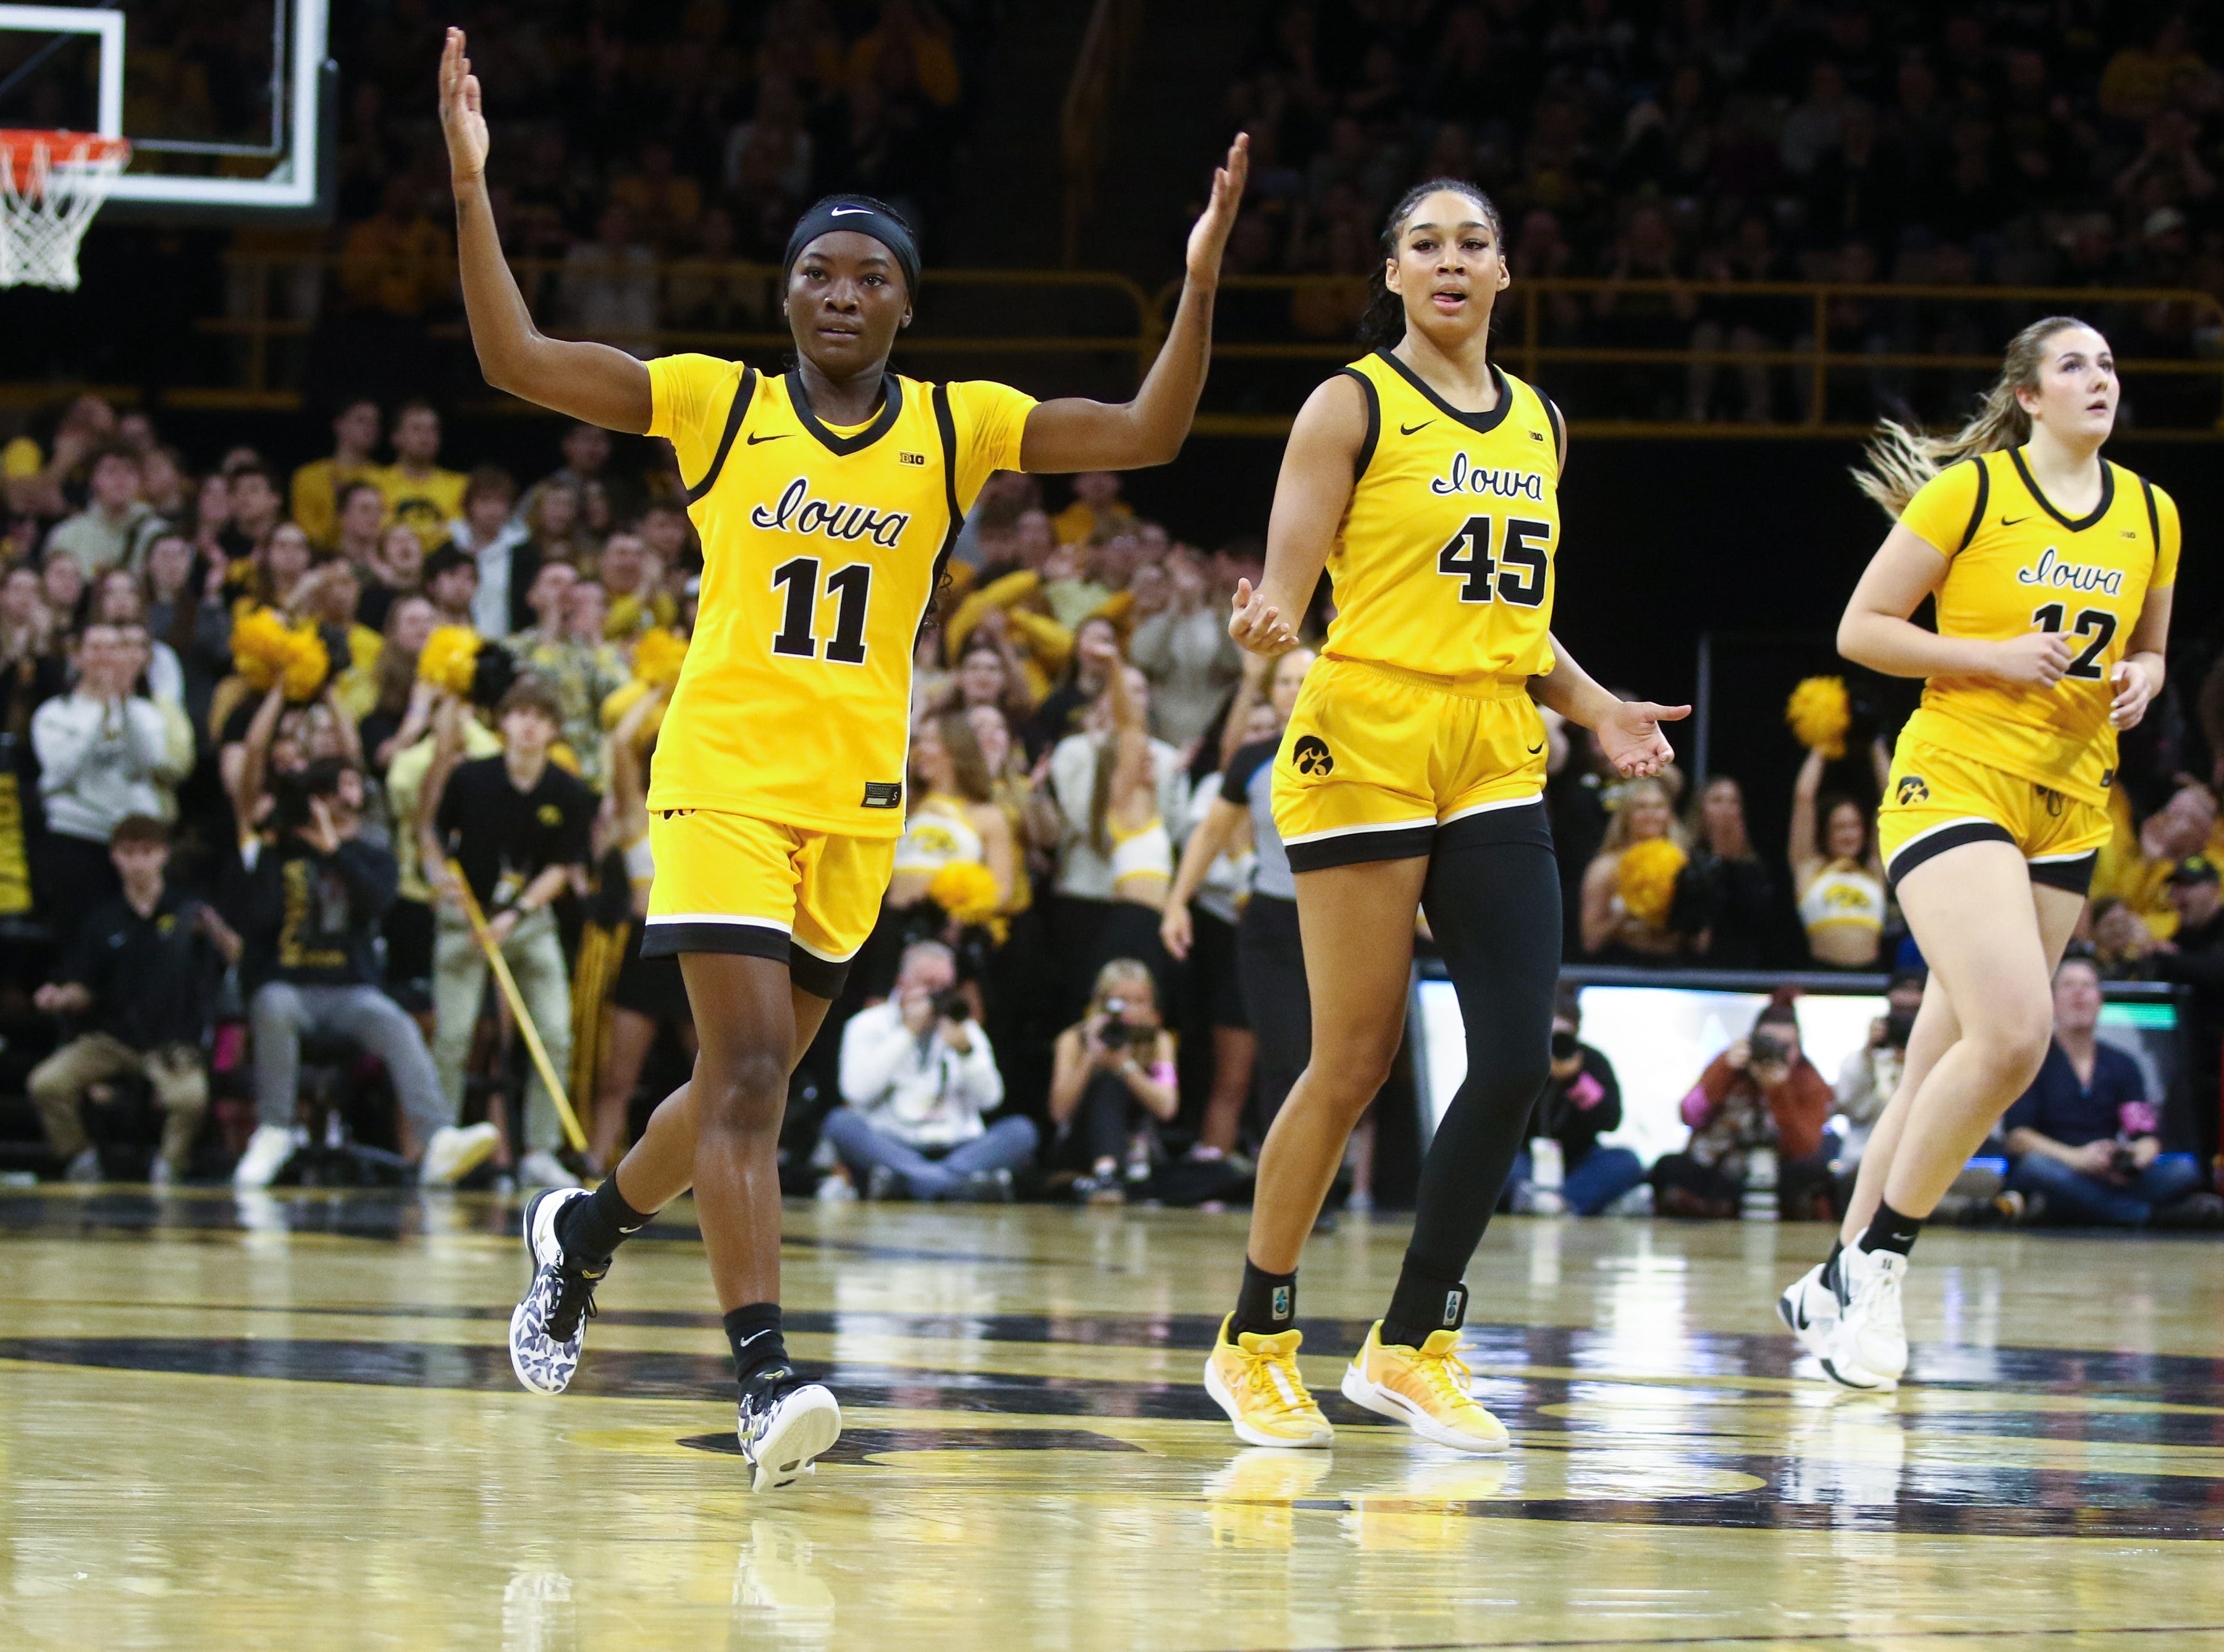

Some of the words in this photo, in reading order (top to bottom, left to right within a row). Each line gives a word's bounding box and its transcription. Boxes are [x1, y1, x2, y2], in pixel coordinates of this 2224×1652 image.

[751, 476, 911, 548] Iowa
[1431, 451, 1543, 502] Iowa
[1437, 515, 1550, 607] 45
[2018, 547, 2123, 596] Iowa
[771, 556, 872, 665] 11
